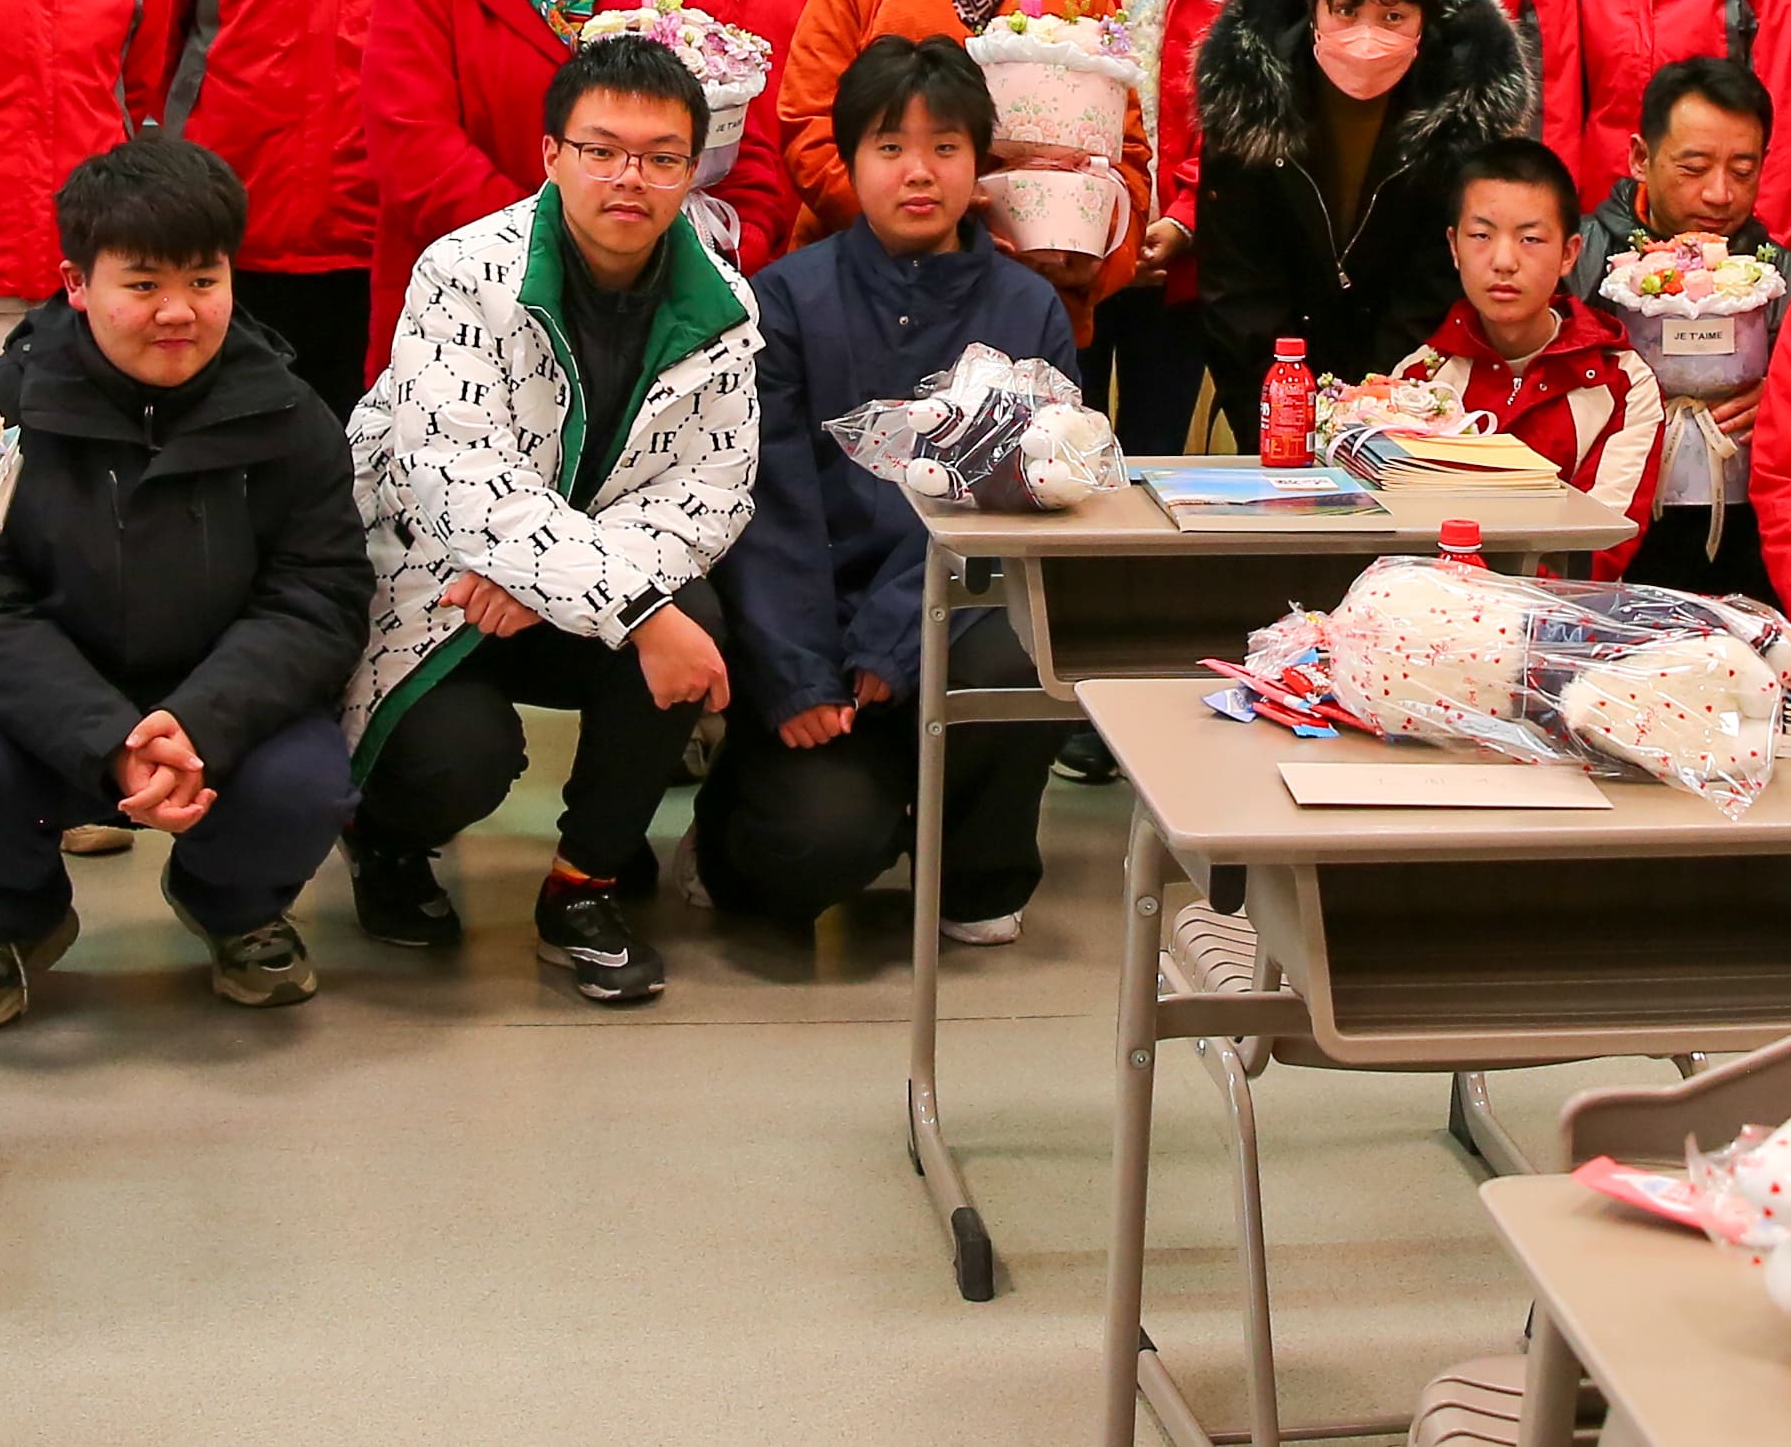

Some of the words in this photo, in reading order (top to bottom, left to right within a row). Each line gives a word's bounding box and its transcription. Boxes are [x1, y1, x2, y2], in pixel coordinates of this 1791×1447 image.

[483, 262, 510, 285] IF
[453, 323, 482, 349] IF
[1673, 332, 1687, 341] JE
[1689, 331, 1723, 341] T'AIME
[458, 379, 490, 406] IF
[518, 426, 544, 457] IF
[649, 431, 677, 454] IF
[710, 429, 739, 452] IF
[485, 471, 518, 501] IF
[679, 493, 710, 521] IF
[528, 524, 560, 557] IF
[582, 578, 615, 614] IF
